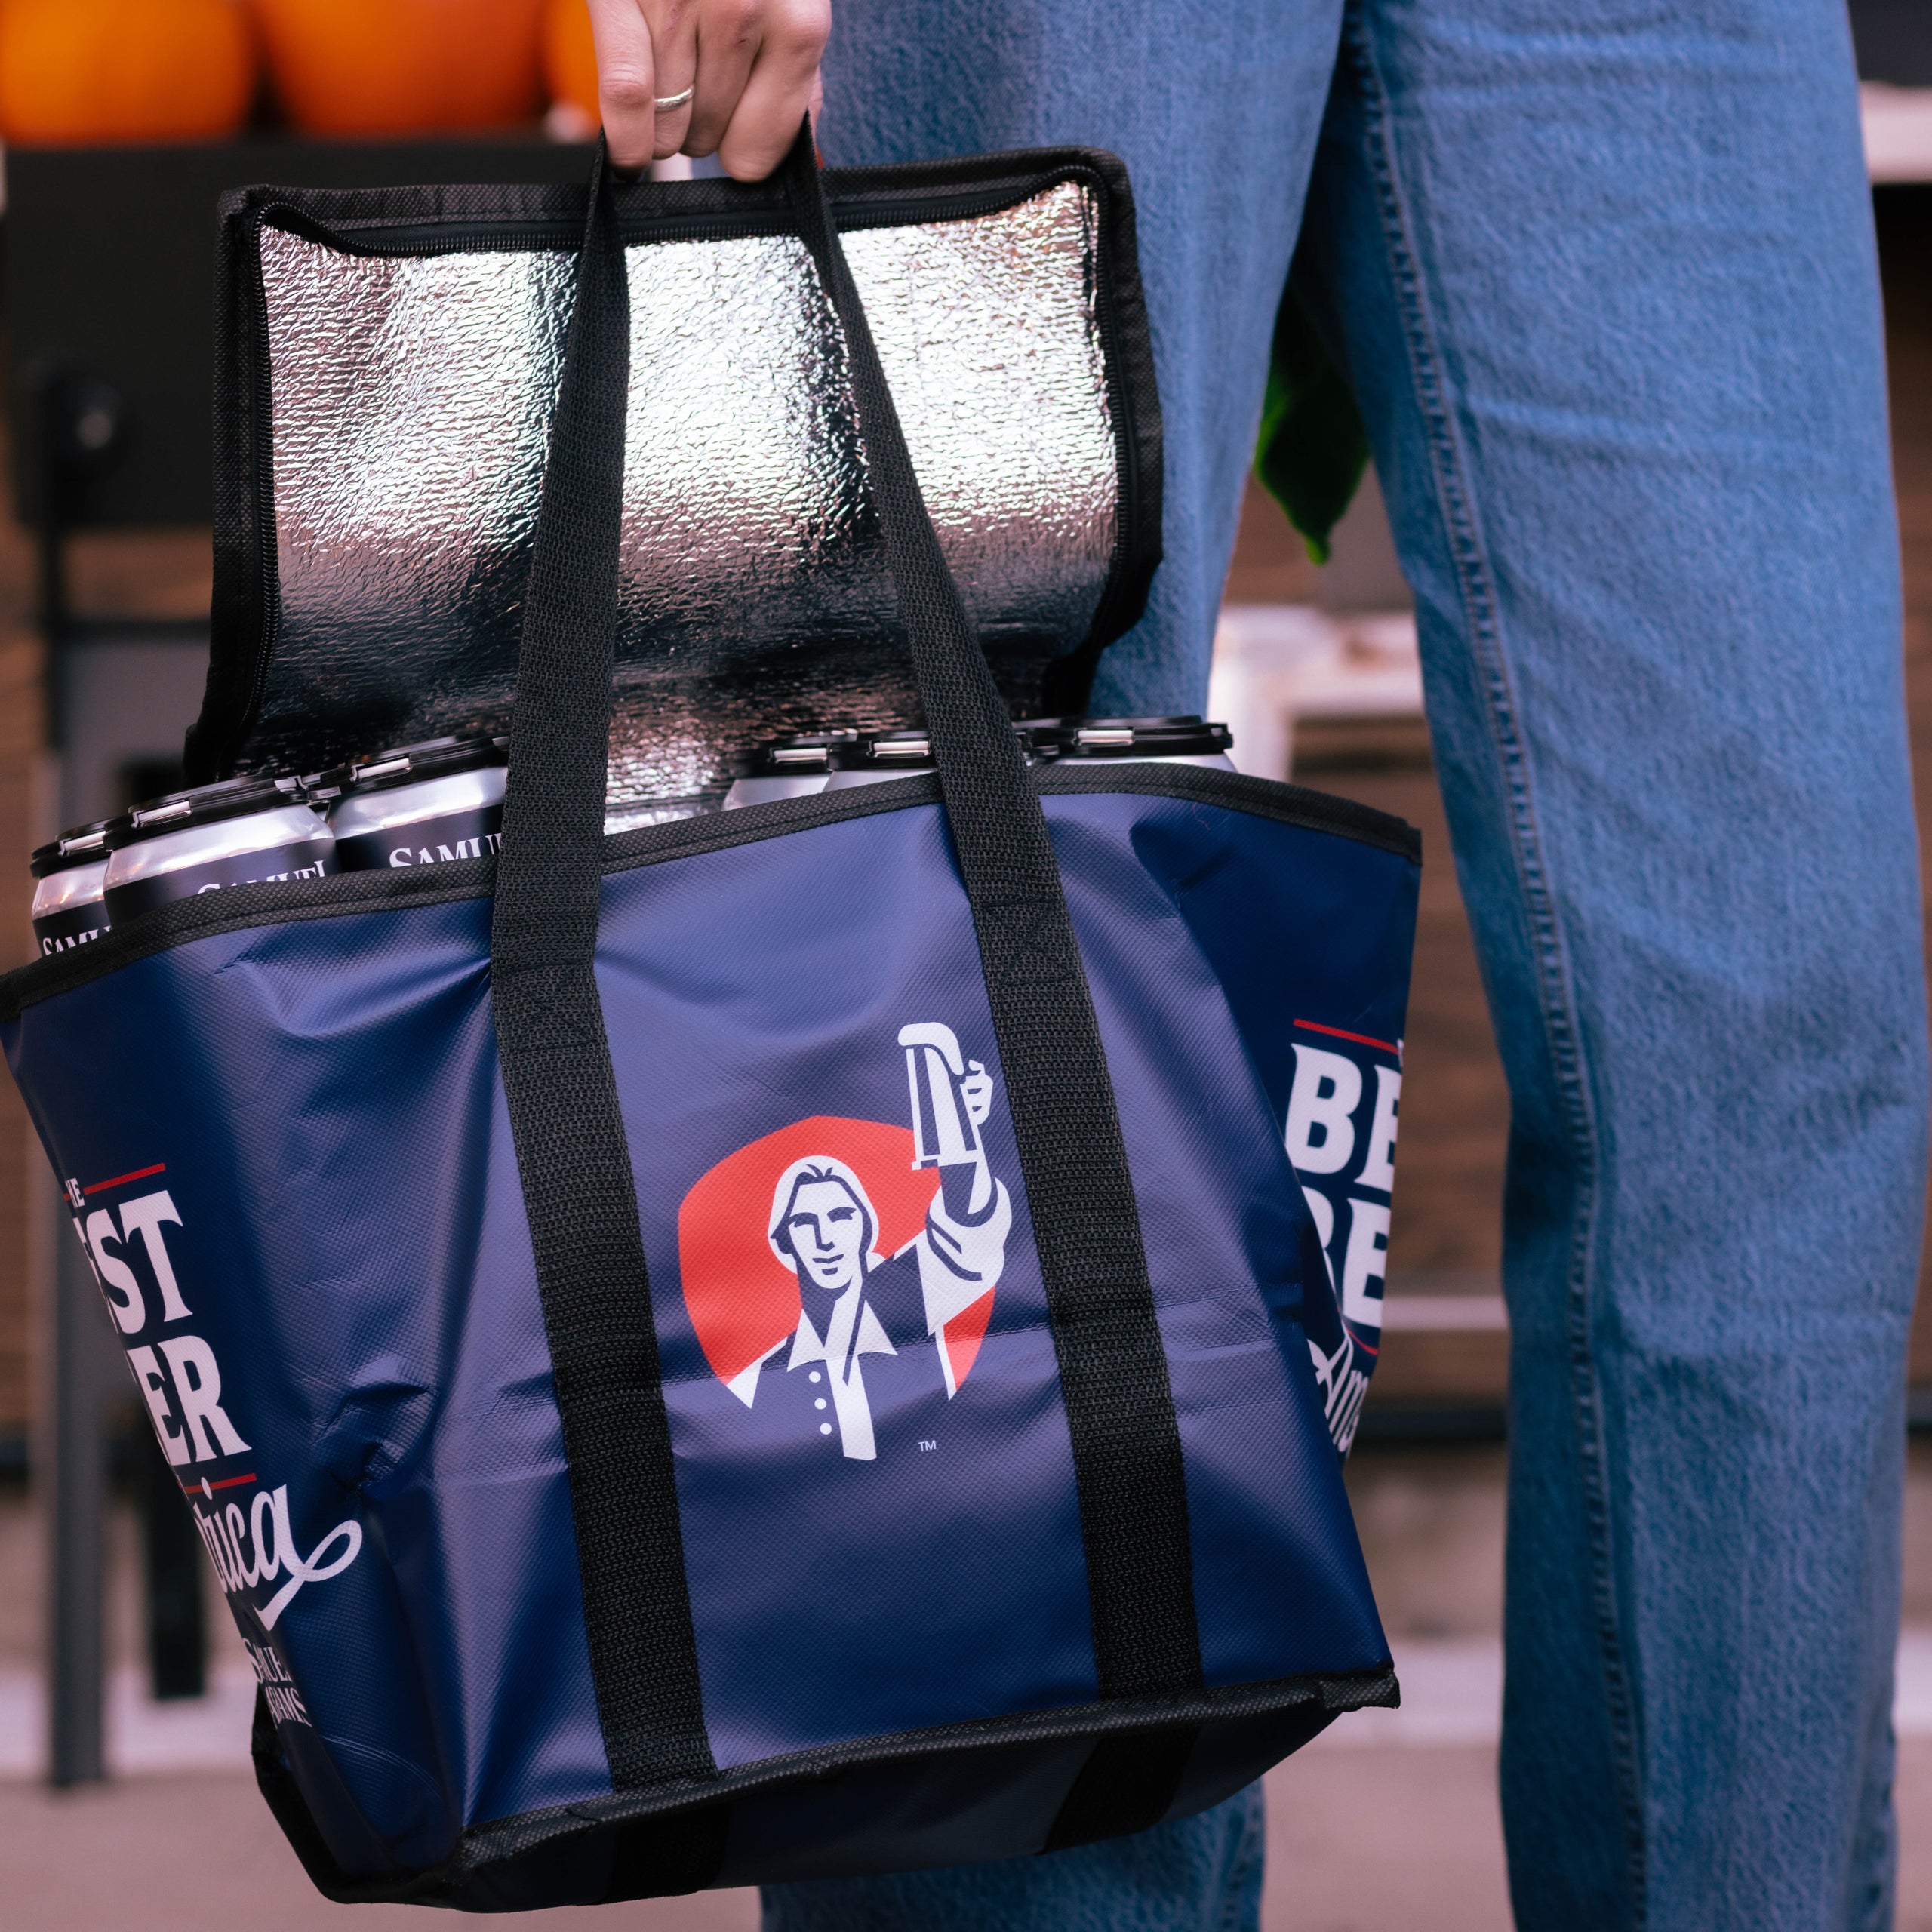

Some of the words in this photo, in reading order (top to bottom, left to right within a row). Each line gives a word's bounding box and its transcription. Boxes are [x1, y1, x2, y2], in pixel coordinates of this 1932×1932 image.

[65, 1177, 85, 1208] HE
[73, 1189, 193, 1334] ST
[124, 1335, 252, 1466] ER
[918, 1440, 937, 1451] TM
[193, 1476, 363, 1632] rica
